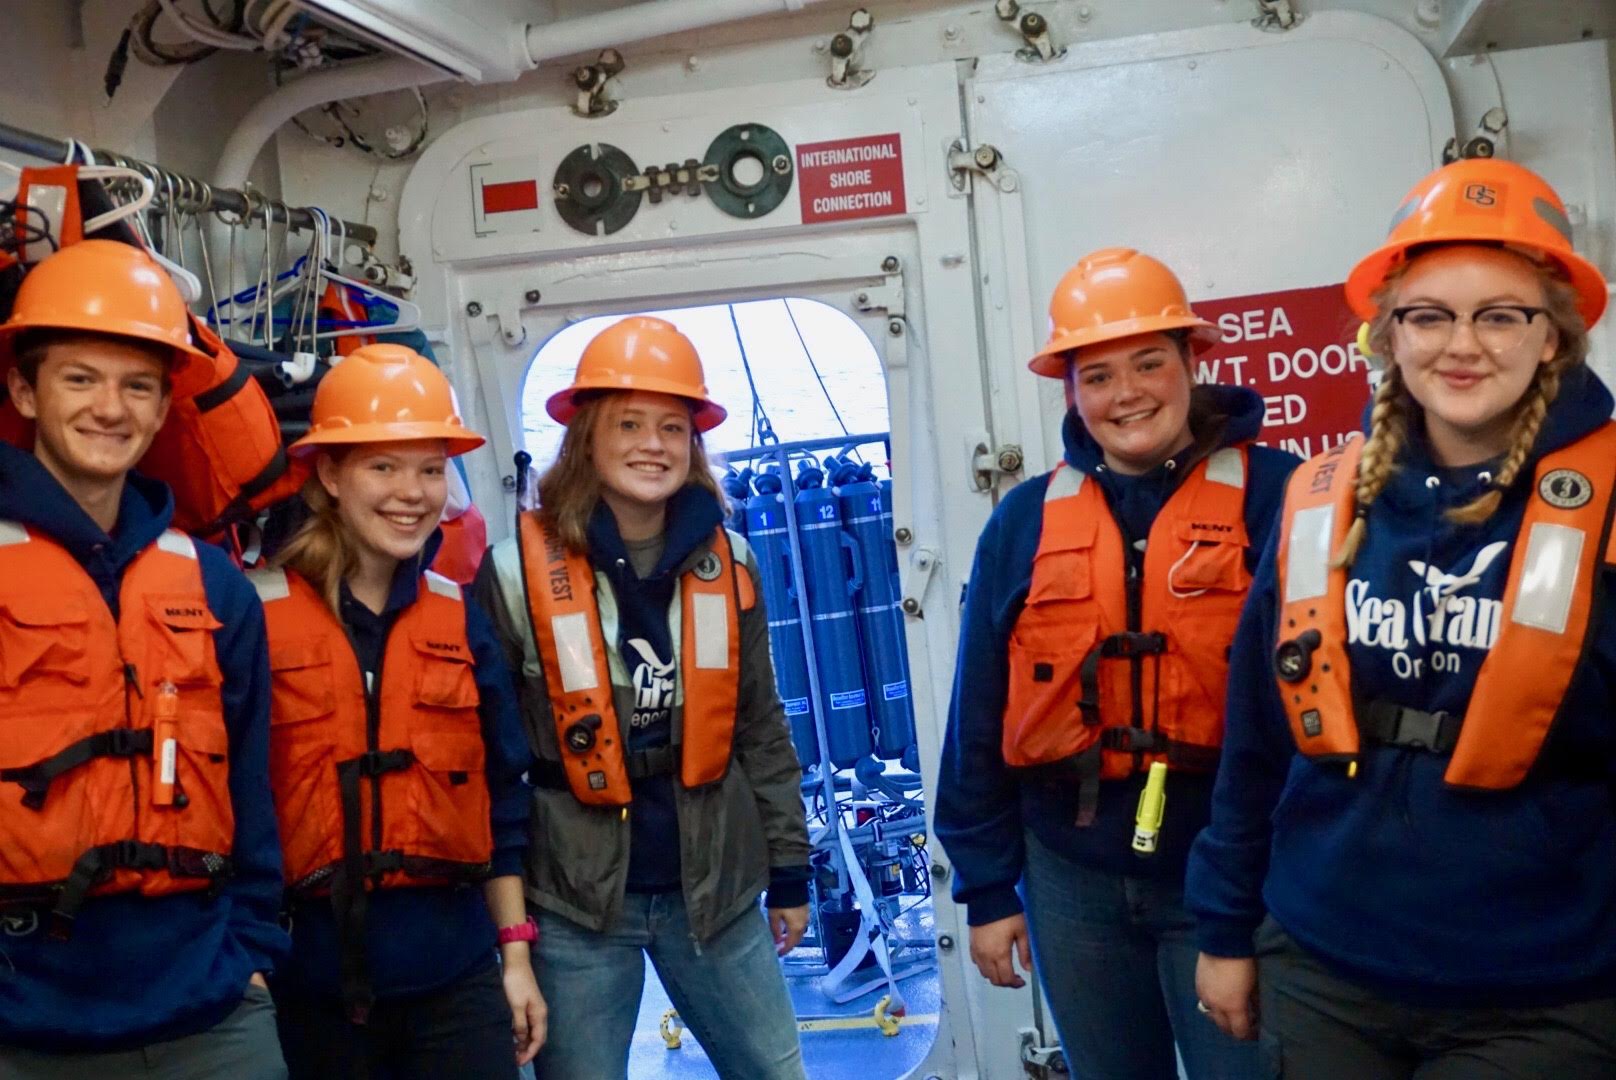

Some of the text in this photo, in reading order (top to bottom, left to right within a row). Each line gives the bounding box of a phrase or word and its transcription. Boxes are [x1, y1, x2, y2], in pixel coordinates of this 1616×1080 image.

[801, 143, 898, 168] INTERNATIONAL
[829, 169, 872, 188] SHORE
[813, 190, 892, 214] CONNECTION
[1217, 306, 1294, 344] SEA
[1309, 461, 1338, 494] VEST
[759, 511, 768, 527] 1
[819, 504, 835, 520] 12
[550, 565, 573, 602] VEST
[1345, 578, 1409, 651] Sea
